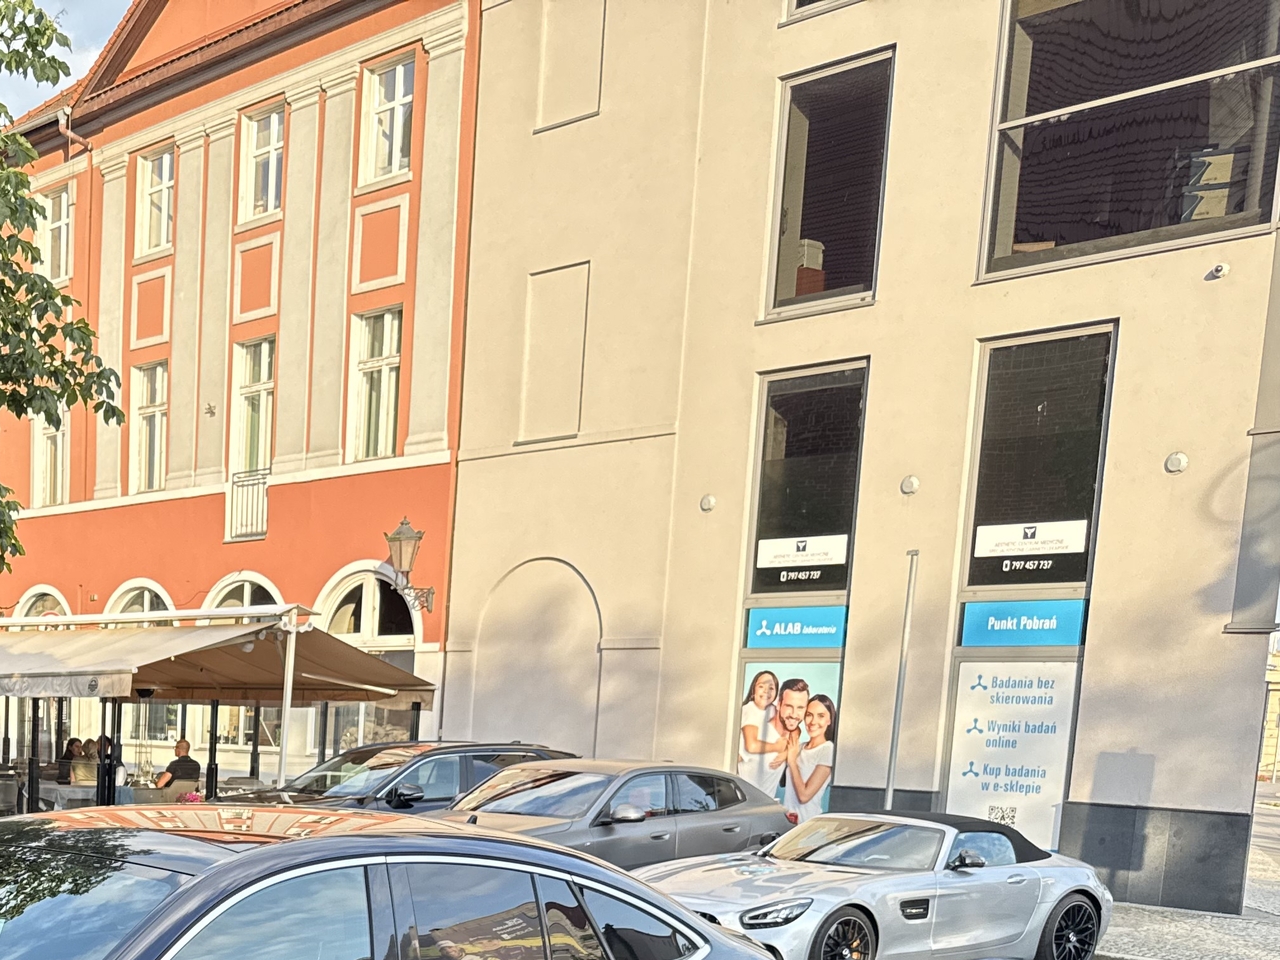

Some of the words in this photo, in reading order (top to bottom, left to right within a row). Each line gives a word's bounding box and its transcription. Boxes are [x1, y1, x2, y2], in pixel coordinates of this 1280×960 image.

[1011, 561, 1024, 570] 797
[1024, 560, 1039, 570] 457
[1039, 560, 1053, 569] 737
[787, 571, 798, 580] 797
[797, 571, 810, 580] 457
[809, 570, 822, 579] 737
[773, 622, 802, 635] ALAB
[987, 616, 1017, 631] Punkt
[1019, 615, 1057, 630] Pobrań
[991, 676, 1033, 689] Badania
[1037, 676, 1056, 689] bez
[989, 691, 1054, 705] skierowania
[987, 720, 1021, 735] Wyniki
[1024, 721, 1057, 734] badań
[985, 736, 1017, 748] online
[982, 763, 1002, 779] Kup
[1005, 764, 1047, 778] badania
[981, 782, 990, 791] w
[993, 780, 1042, 796] e-sklepie
